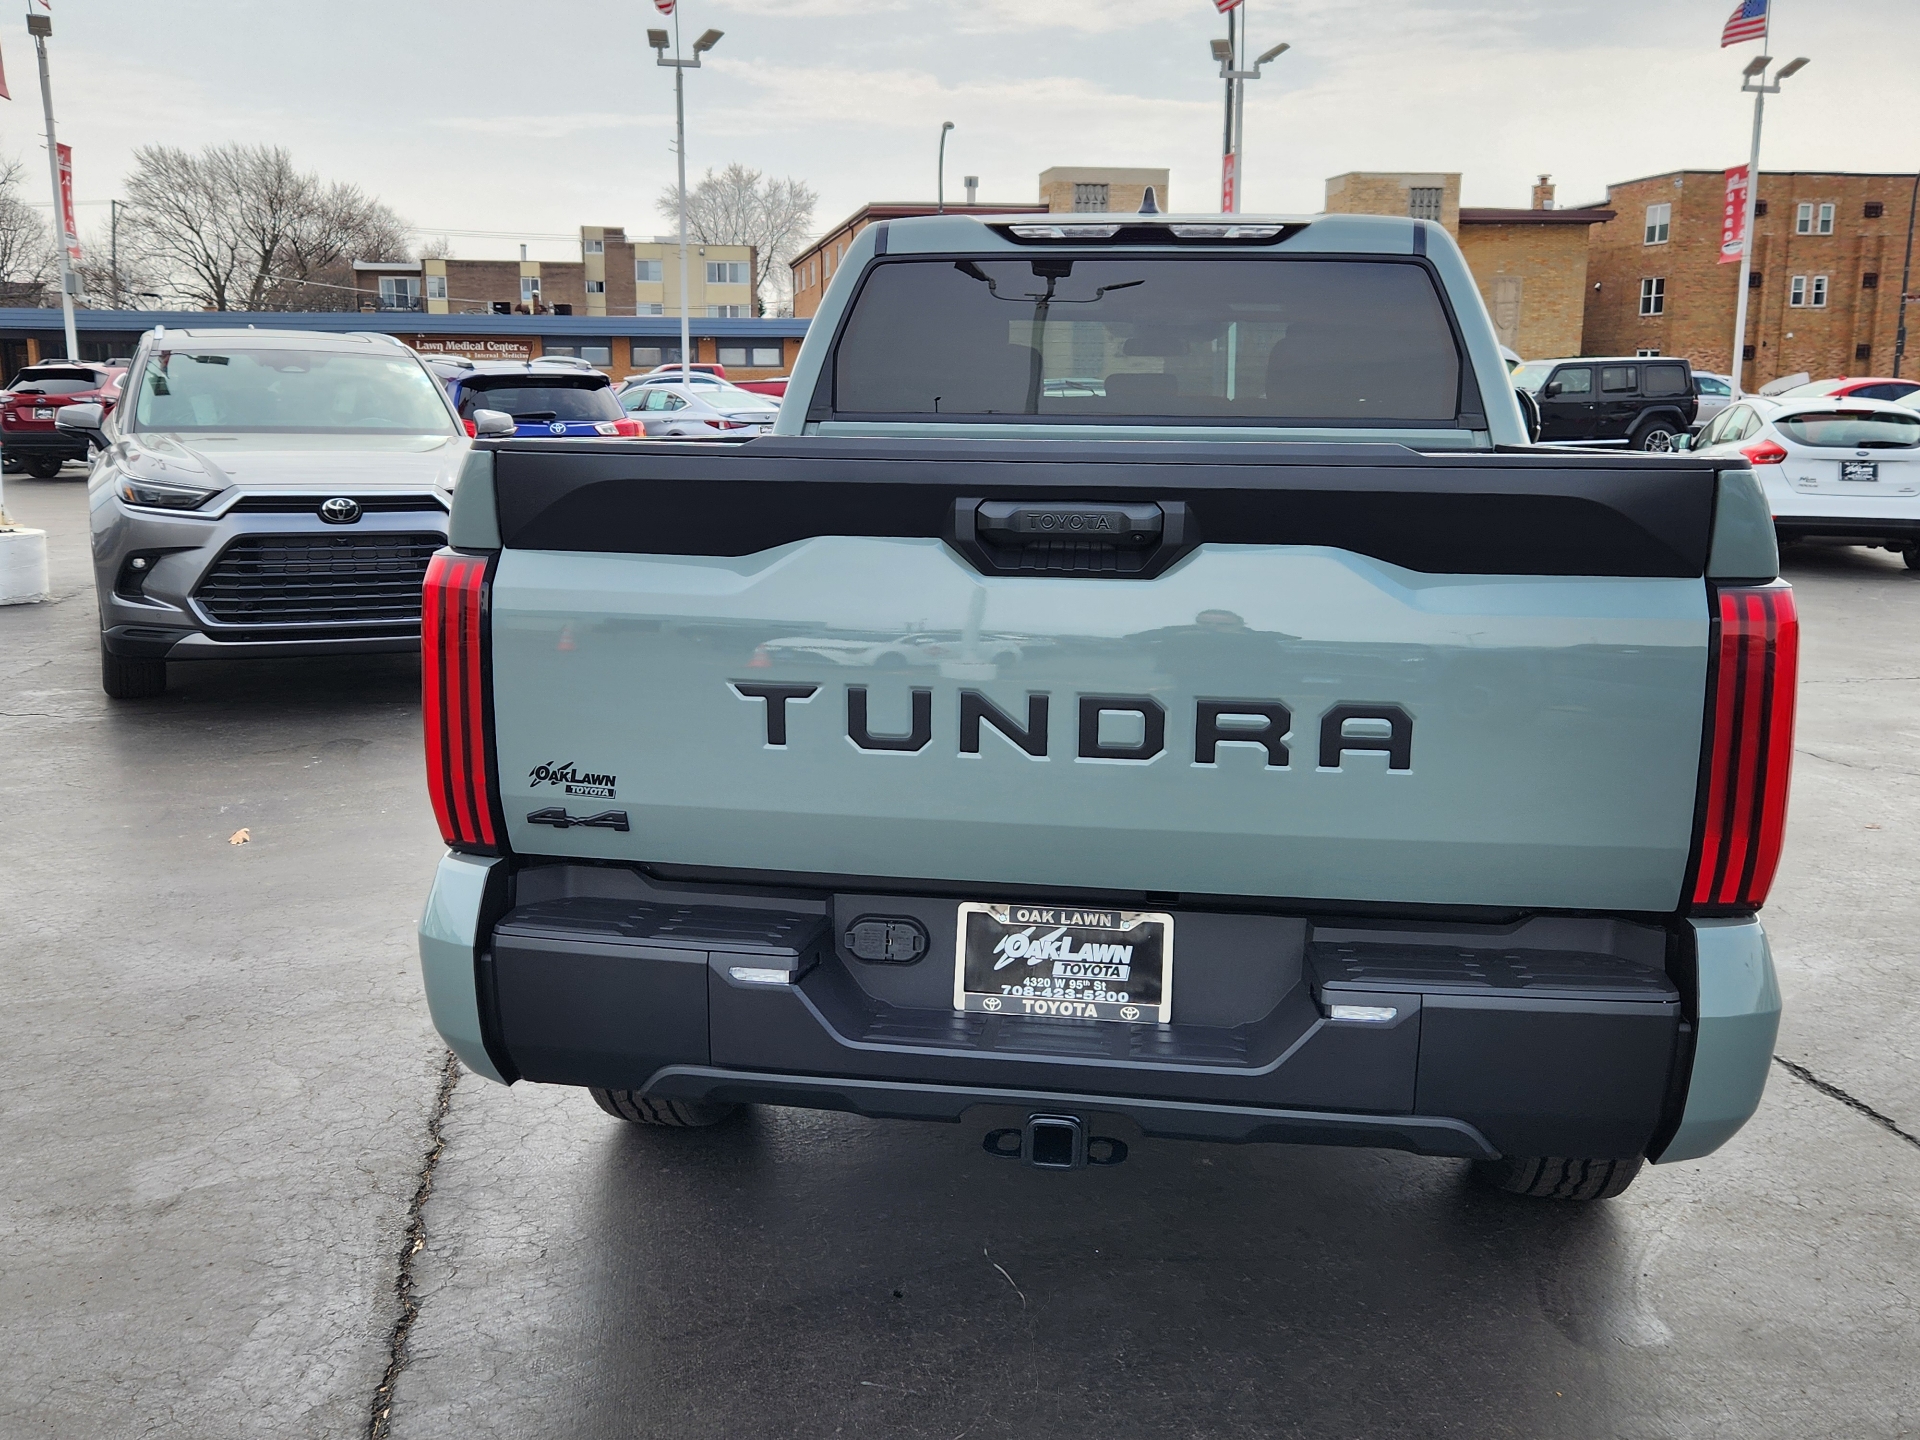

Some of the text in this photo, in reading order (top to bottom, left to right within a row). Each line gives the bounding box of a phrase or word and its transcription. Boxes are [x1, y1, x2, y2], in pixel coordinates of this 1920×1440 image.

[416, 341, 444, 351] Lawn
[445, 341, 484, 351] Medical
[487, 342, 520, 352] Center
[1027, 513, 1111, 531] TOYOTA
[727, 682, 1414, 774] TUNDRA
[570, 785, 609, 797] TOYOTA
[1016, 909, 1112, 927] OAK LAWN
[1061, 963, 1121, 978] TOYOTA
[1023, 977, 1107, 991] 4320 W 95th St
[1001, 985, 1129, 1003] 708-423-5200
[1022, 999, 1098, 1018] TOYOTA
